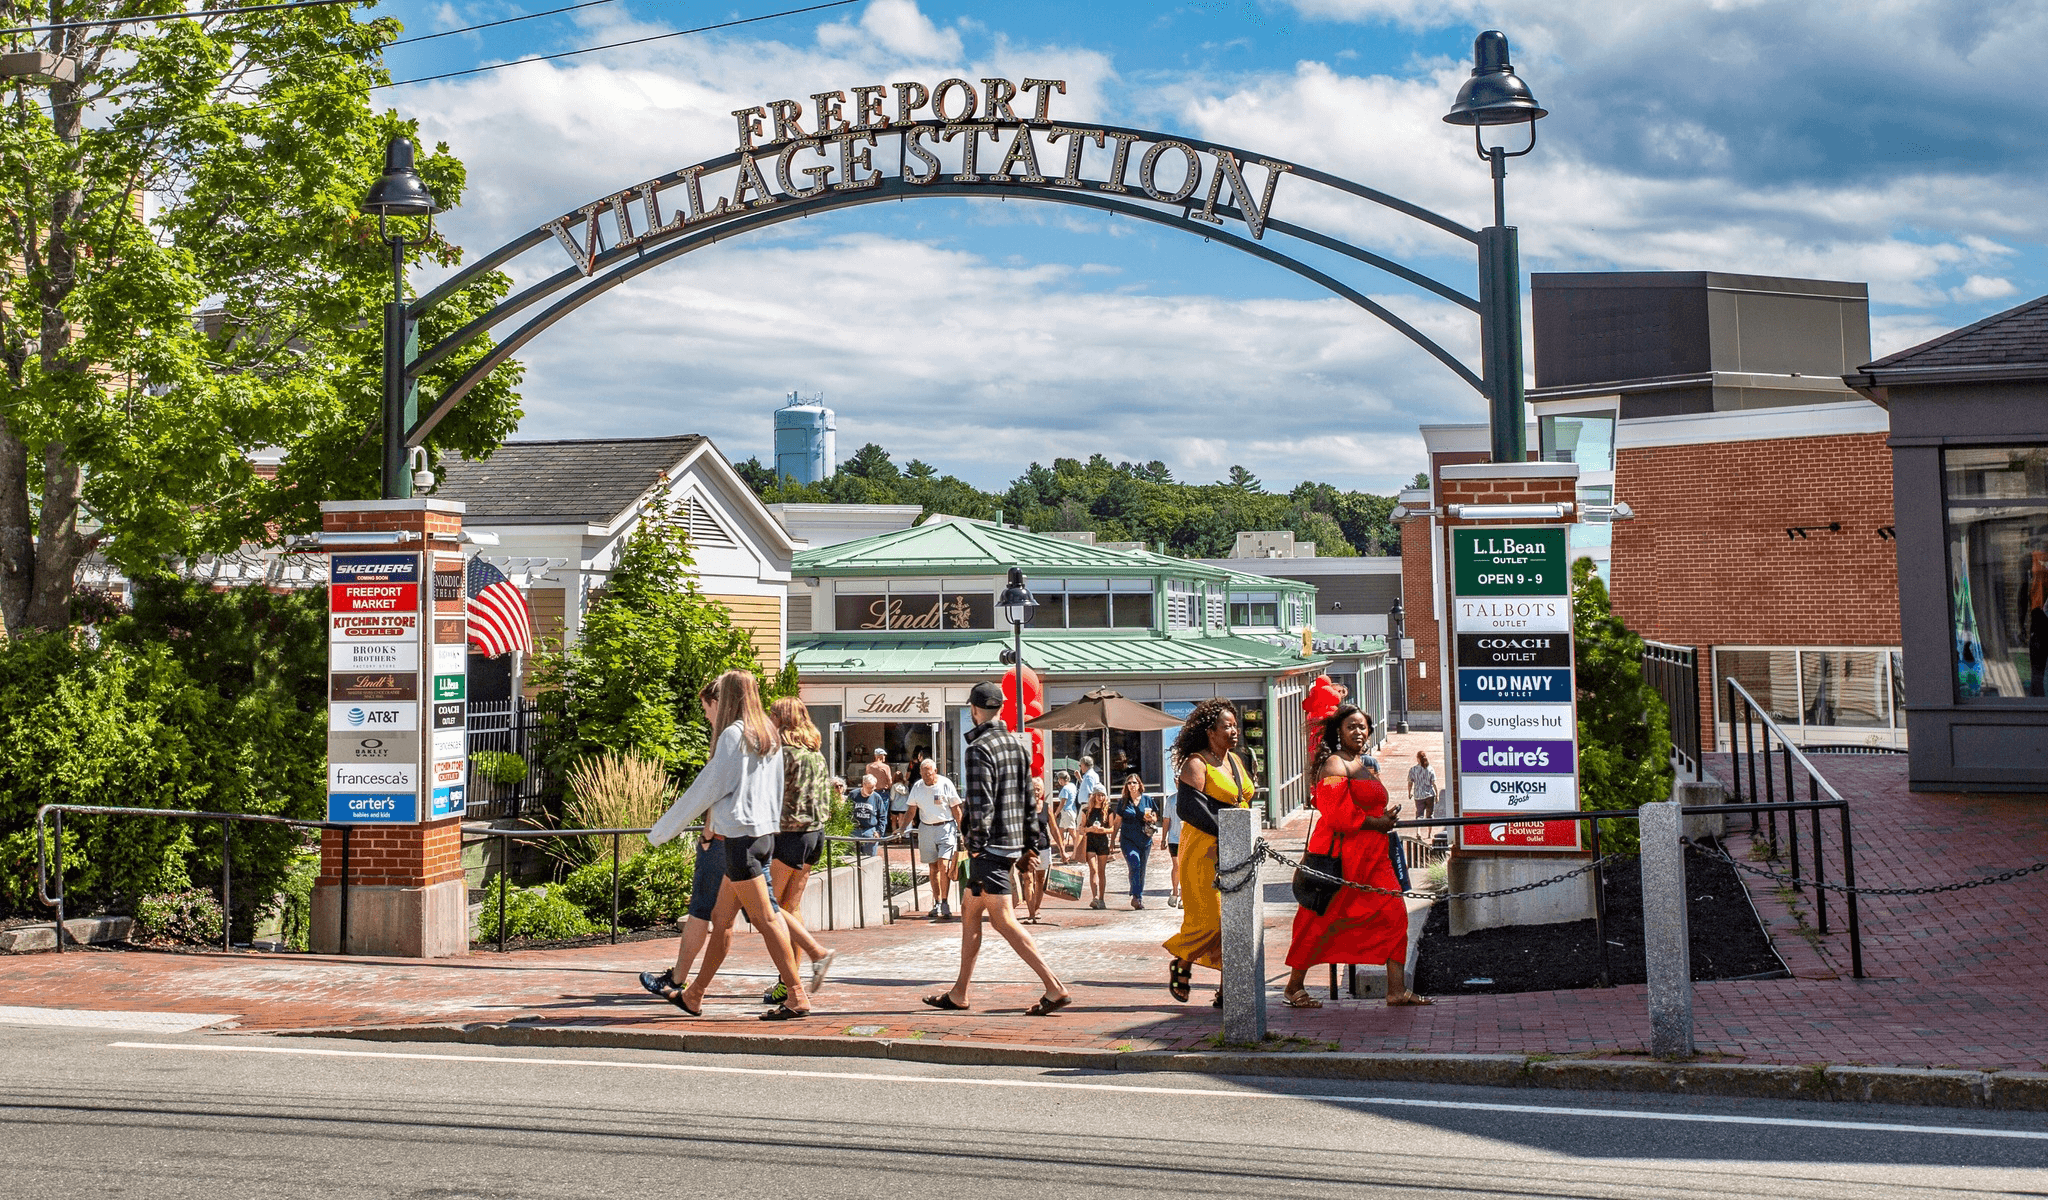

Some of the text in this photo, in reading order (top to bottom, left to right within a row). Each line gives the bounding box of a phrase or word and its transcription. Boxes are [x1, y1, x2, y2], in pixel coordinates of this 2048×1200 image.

[730, 77, 1066, 153] FREEPORT
[540, 123, 1294, 278] VILLAGE STATION
[1473, 538, 1546, 554] L.L.Bean
[336, 563, 414, 574] SKECHERS
[1477, 573, 1514, 585] OPEN
[1516, 573, 1525, 585] 9
[1535, 573, 1543, 585] 9
[346, 587, 402, 597] FREEPORT
[352, 599, 397, 609] MARKET
[1462, 603, 1556, 617] TALBOTS
[860, 599, 950, 630] Lindt
[333, 616, 416, 629] KITCHEN STORE
[353, 646, 396, 654] BROOKS
[1477, 638, 1551, 649] COACH
[1492, 652, 1537, 662] OUTLET
[352, 675, 387, 688] Lindt
[1476, 675, 1553, 691] OLD NAVY
[858, 693, 916, 713] Lindt
[367, 711, 399, 723] AT&T
[1486, 714, 1562, 730] sunglass hut
[1477, 745, 1550, 767] claire's
[336, 768, 409, 785] francesca's
[348, 796, 396, 810] carter's
[1508, 827, 1546, 835] Footwear
